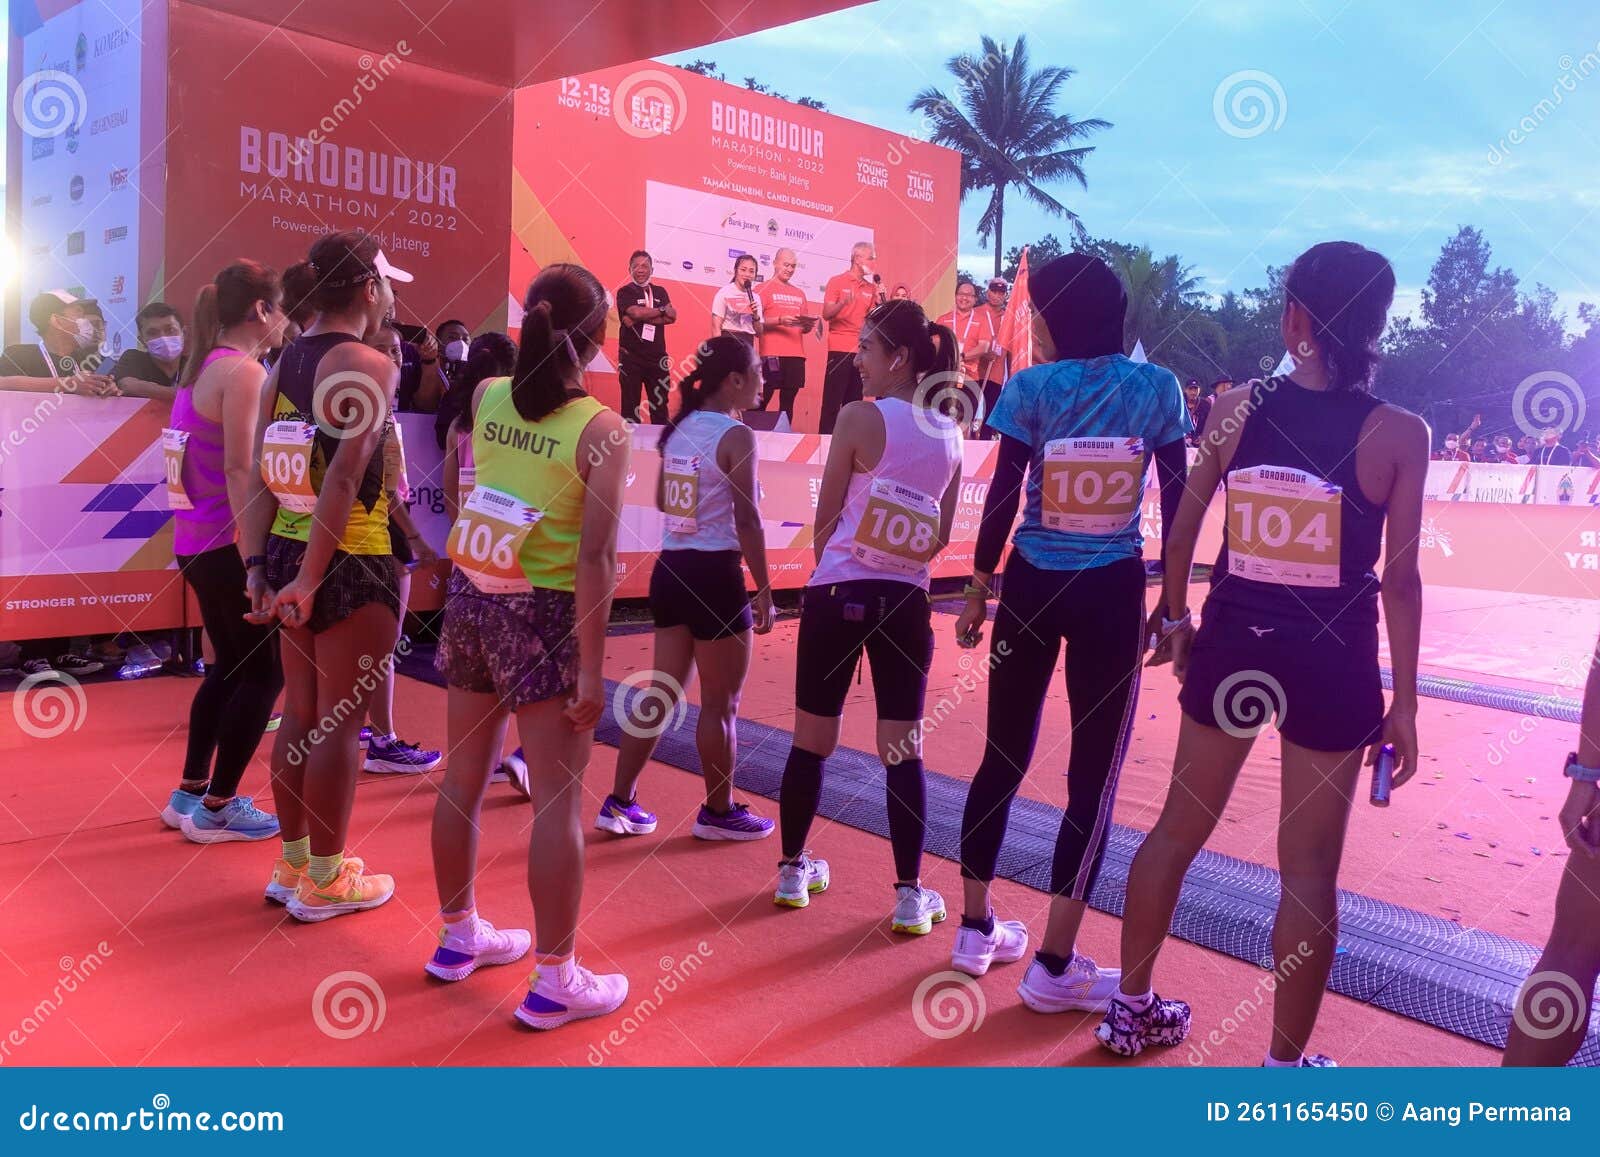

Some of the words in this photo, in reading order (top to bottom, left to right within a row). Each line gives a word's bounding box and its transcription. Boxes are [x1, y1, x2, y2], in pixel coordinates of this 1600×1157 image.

[558, 96, 581, 109] NOV
[584, 102, 610, 117] 2022
[632, 95, 672, 120] ELITE
[632, 112, 672, 135] RACE
[712, 100, 824, 159] BOROBUDUR
[240, 126, 456, 208] BOROBUDUR
[712, 135, 782, 162] MARATHON
[797, 158, 824, 174] 2022
[857, 162, 888, 178] YOUNG
[727, 158, 757, 173] Powered
[770, 167, 787, 181] Bank
[788, 174, 809, 190] Jateng
[856, 173, 888, 189] TALENT
[907, 174, 934, 192] TILIK
[240, 182, 377, 218] MARATHON
[408, 210, 457, 231] 2022
[703, 176, 730, 189] TAMAN
[767, 192, 790, 203] CANDI
[791, 198, 833, 213] BOROBUDUR
[907, 188, 934, 203] CANDI
[272, 216, 328, 235] Powered
[391, 232, 430, 257] Jateng
[784, 227, 816, 241] KOMPAS
[483, 421, 561, 459] SUMUT
[1073, 441, 1114, 449] BOROBUDUR
[264, 452, 306, 486] 109
[1260, 469, 1306, 484] BOROBUDUR
[664, 480, 693, 509] 103
[1050, 470, 1134, 505] 102
[870, 508, 933, 553] 108
[1234, 502, 1333, 552] 104
[456, 519, 514, 570] 106
[6, 597, 75, 610] STRONGER
[80, 596, 97, 606] TO
[100, 593, 152, 604] VICTORY
